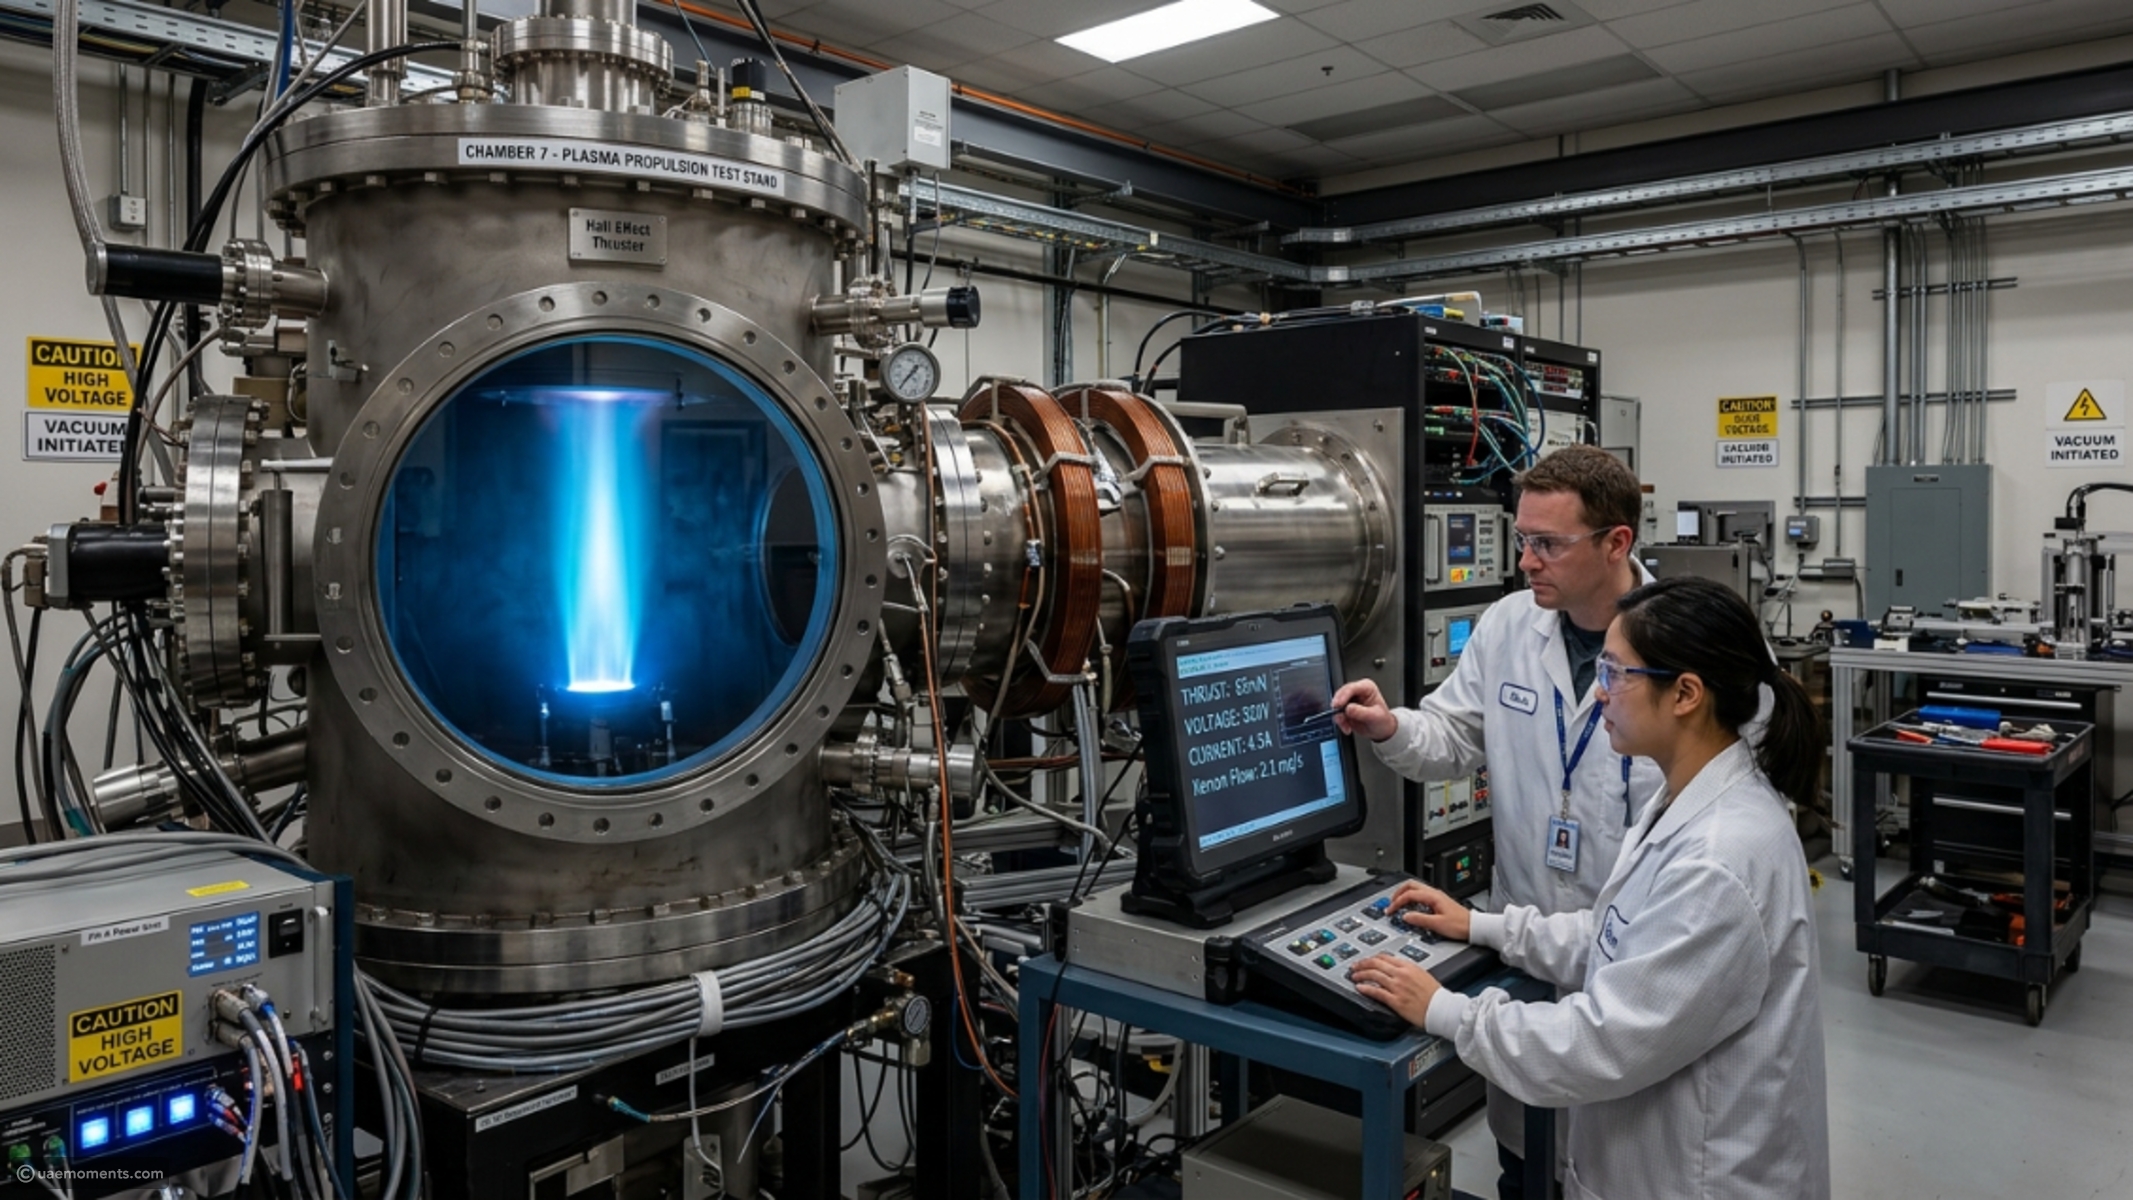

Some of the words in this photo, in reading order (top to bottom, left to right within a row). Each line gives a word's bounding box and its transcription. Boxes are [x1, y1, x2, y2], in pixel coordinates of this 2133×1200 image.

[466, 145, 535, 160] CHAMBER
[540, 147, 549, 160] 7
[562, 148, 620, 166] PLASMA
[625, 153, 709, 176] PROPULSION
[712, 164, 741, 181] TEST
[744, 171, 778, 188] STAND
[586, 219, 611, 233] Hall
[63, 371, 109, 387] HIGH
[44, 387, 127, 406] VOLTAGE
[44, 420, 126, 435] VACUUM
[2055, 435, 2115, 446] VACUUM
[2051, 449, 2119, 460] INITIATED
[1180, 681, 1231, 706] THRUST:
[1184, 708, 1240, 736] VOLTAGE:
[1188, 737, 1246, 766] CURRENT:
[76, 997, 174, 1033] CAUTION
[101, 1025, 152, 1051] HIGH
[79, 1038, 174, 1075] VOLTAGE
